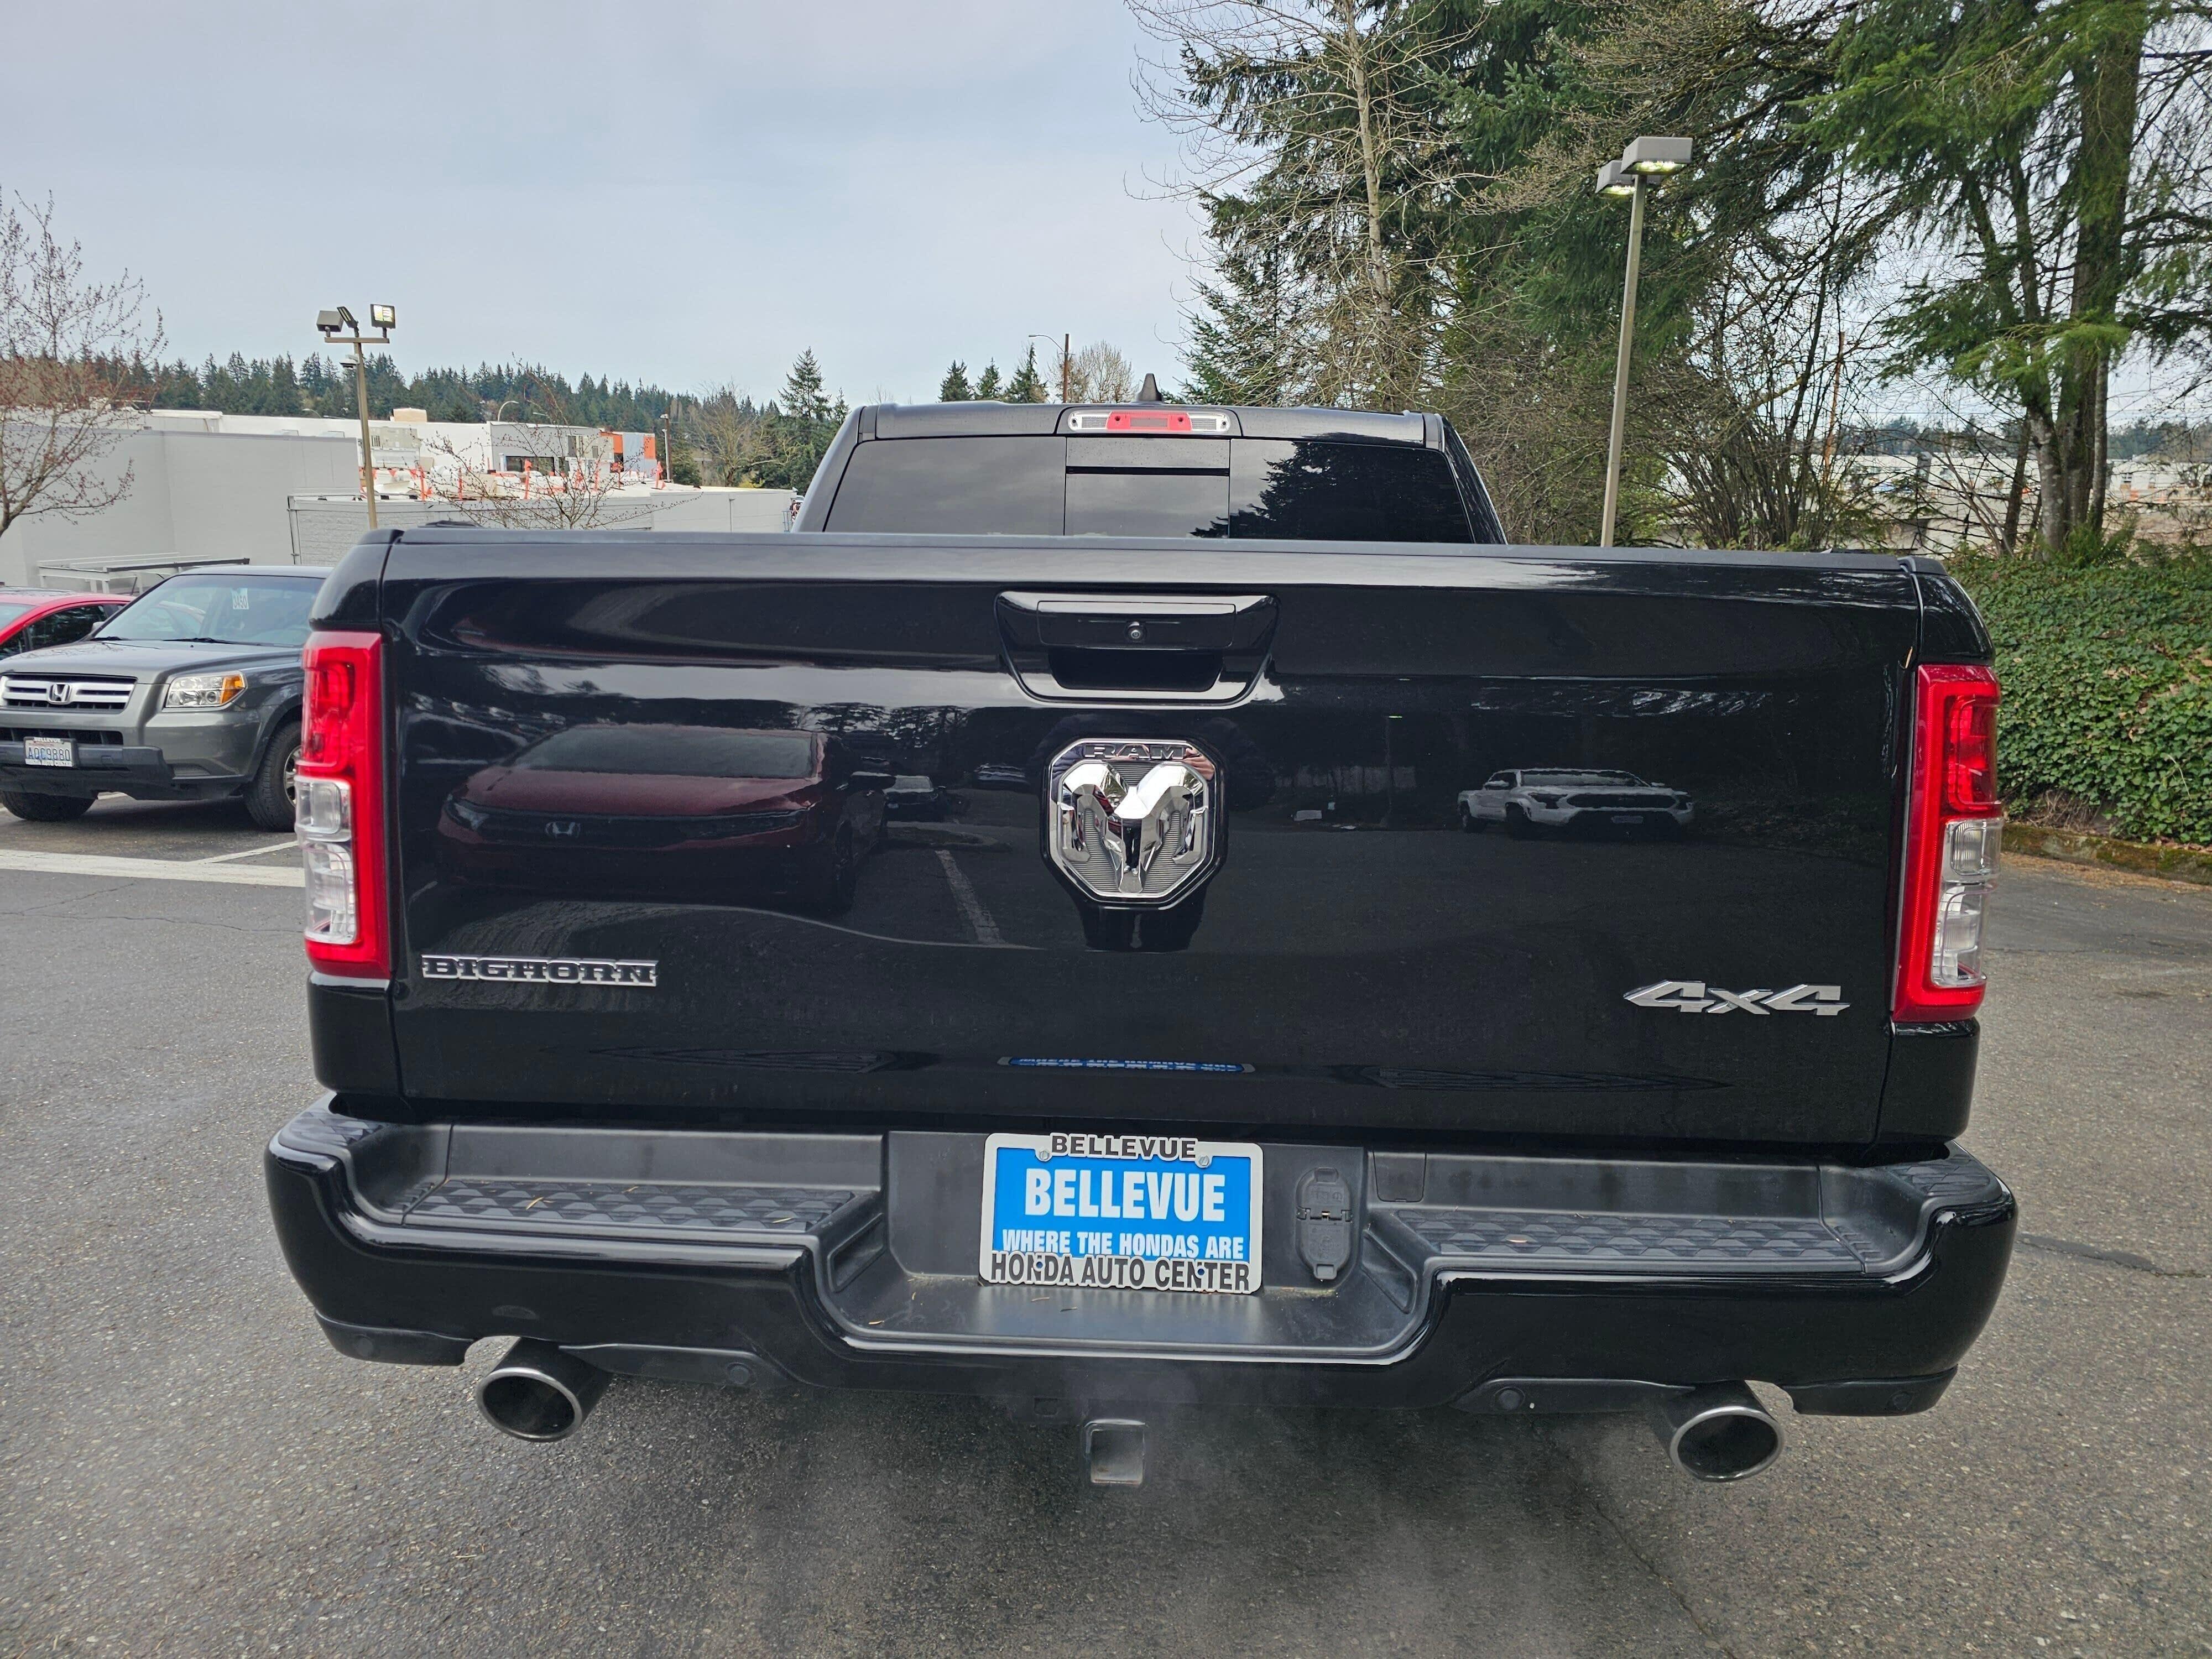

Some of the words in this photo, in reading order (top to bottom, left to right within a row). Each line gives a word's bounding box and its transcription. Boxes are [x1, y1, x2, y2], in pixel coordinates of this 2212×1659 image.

[29, 748, 70, 761] AQC9880
[1084, 744, 1184, 759] RAM
[421, 954, 659, 987] BIGHORN
[1051, 1135, 1197, 1159] BELLEVUE
[1025, 1168, 1225, 1222] BELLEVUE
[1003, 1229, 1071, 1254] WHERE
[1077, 1231, 1112, 1255] THE
[1119, 1233, 1199, 1258] HONDAS
[1205, 1235, 1244, 1260] ARE
[992, 1252, 1074, 1284] HONDA
[1081, 1255, 1145, 1286] AUTO
[1155, 1259, 1250, 1291] CENTER
